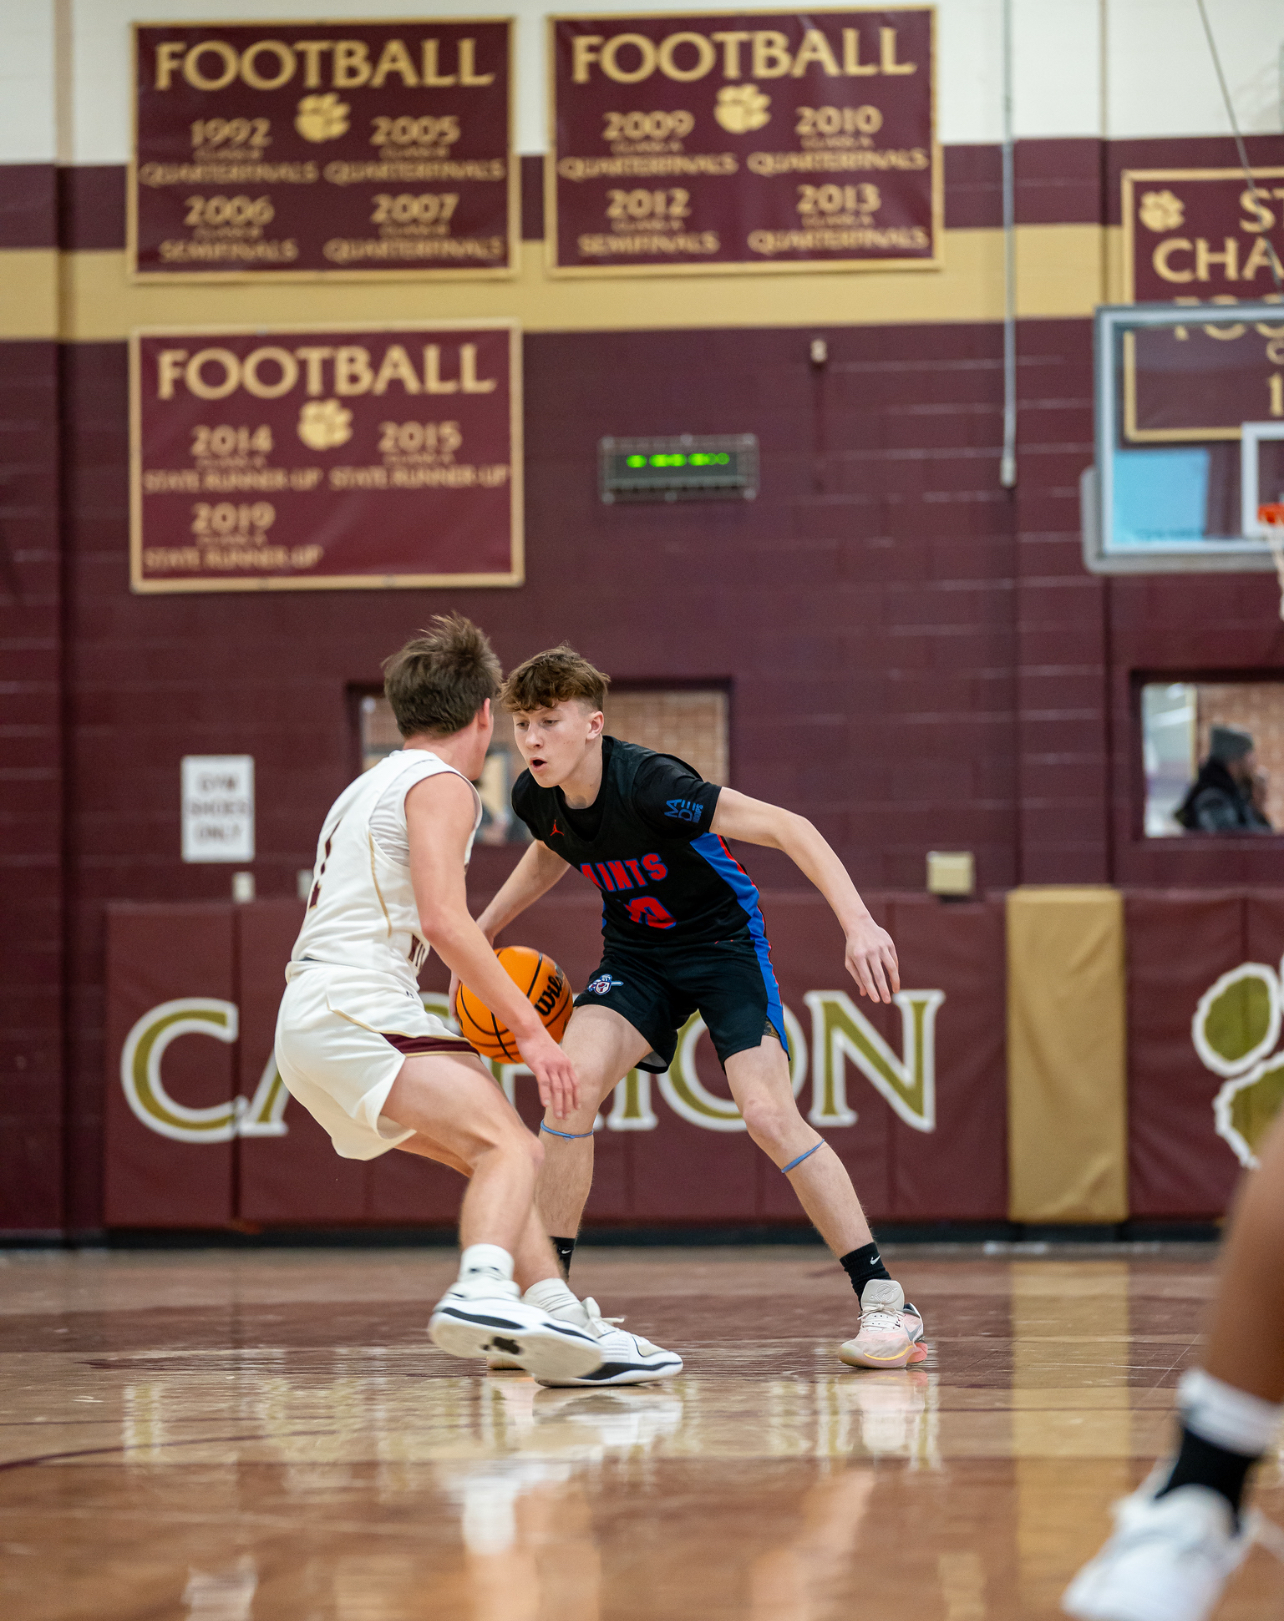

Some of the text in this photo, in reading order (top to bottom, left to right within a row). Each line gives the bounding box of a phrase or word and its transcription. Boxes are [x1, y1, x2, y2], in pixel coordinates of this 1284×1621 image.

[155, 38, 495, 91] FOOTBALL
[571, 27, 918, 84] FOOTBALL
[190, 117, 273, 148] 1992
[369, 115, 461, 145] 2005
[601, 110, 696, 141] 2009
[795, 106, 883, 135] 2010
[183, 194, 276, 226] 2006
[370, 193, 460, 225] 2007
[605, 188, 692, 218] 2012
[796, 183, 881, 215] 2013
[157, 343, 497, 400] FOOTBALL
[190, 424, 274, 456] 2014
[377, 421, 463, 453] 2015
[190, 502, 276, 535] 2019
[580, 853, 668, 892] AINTS
